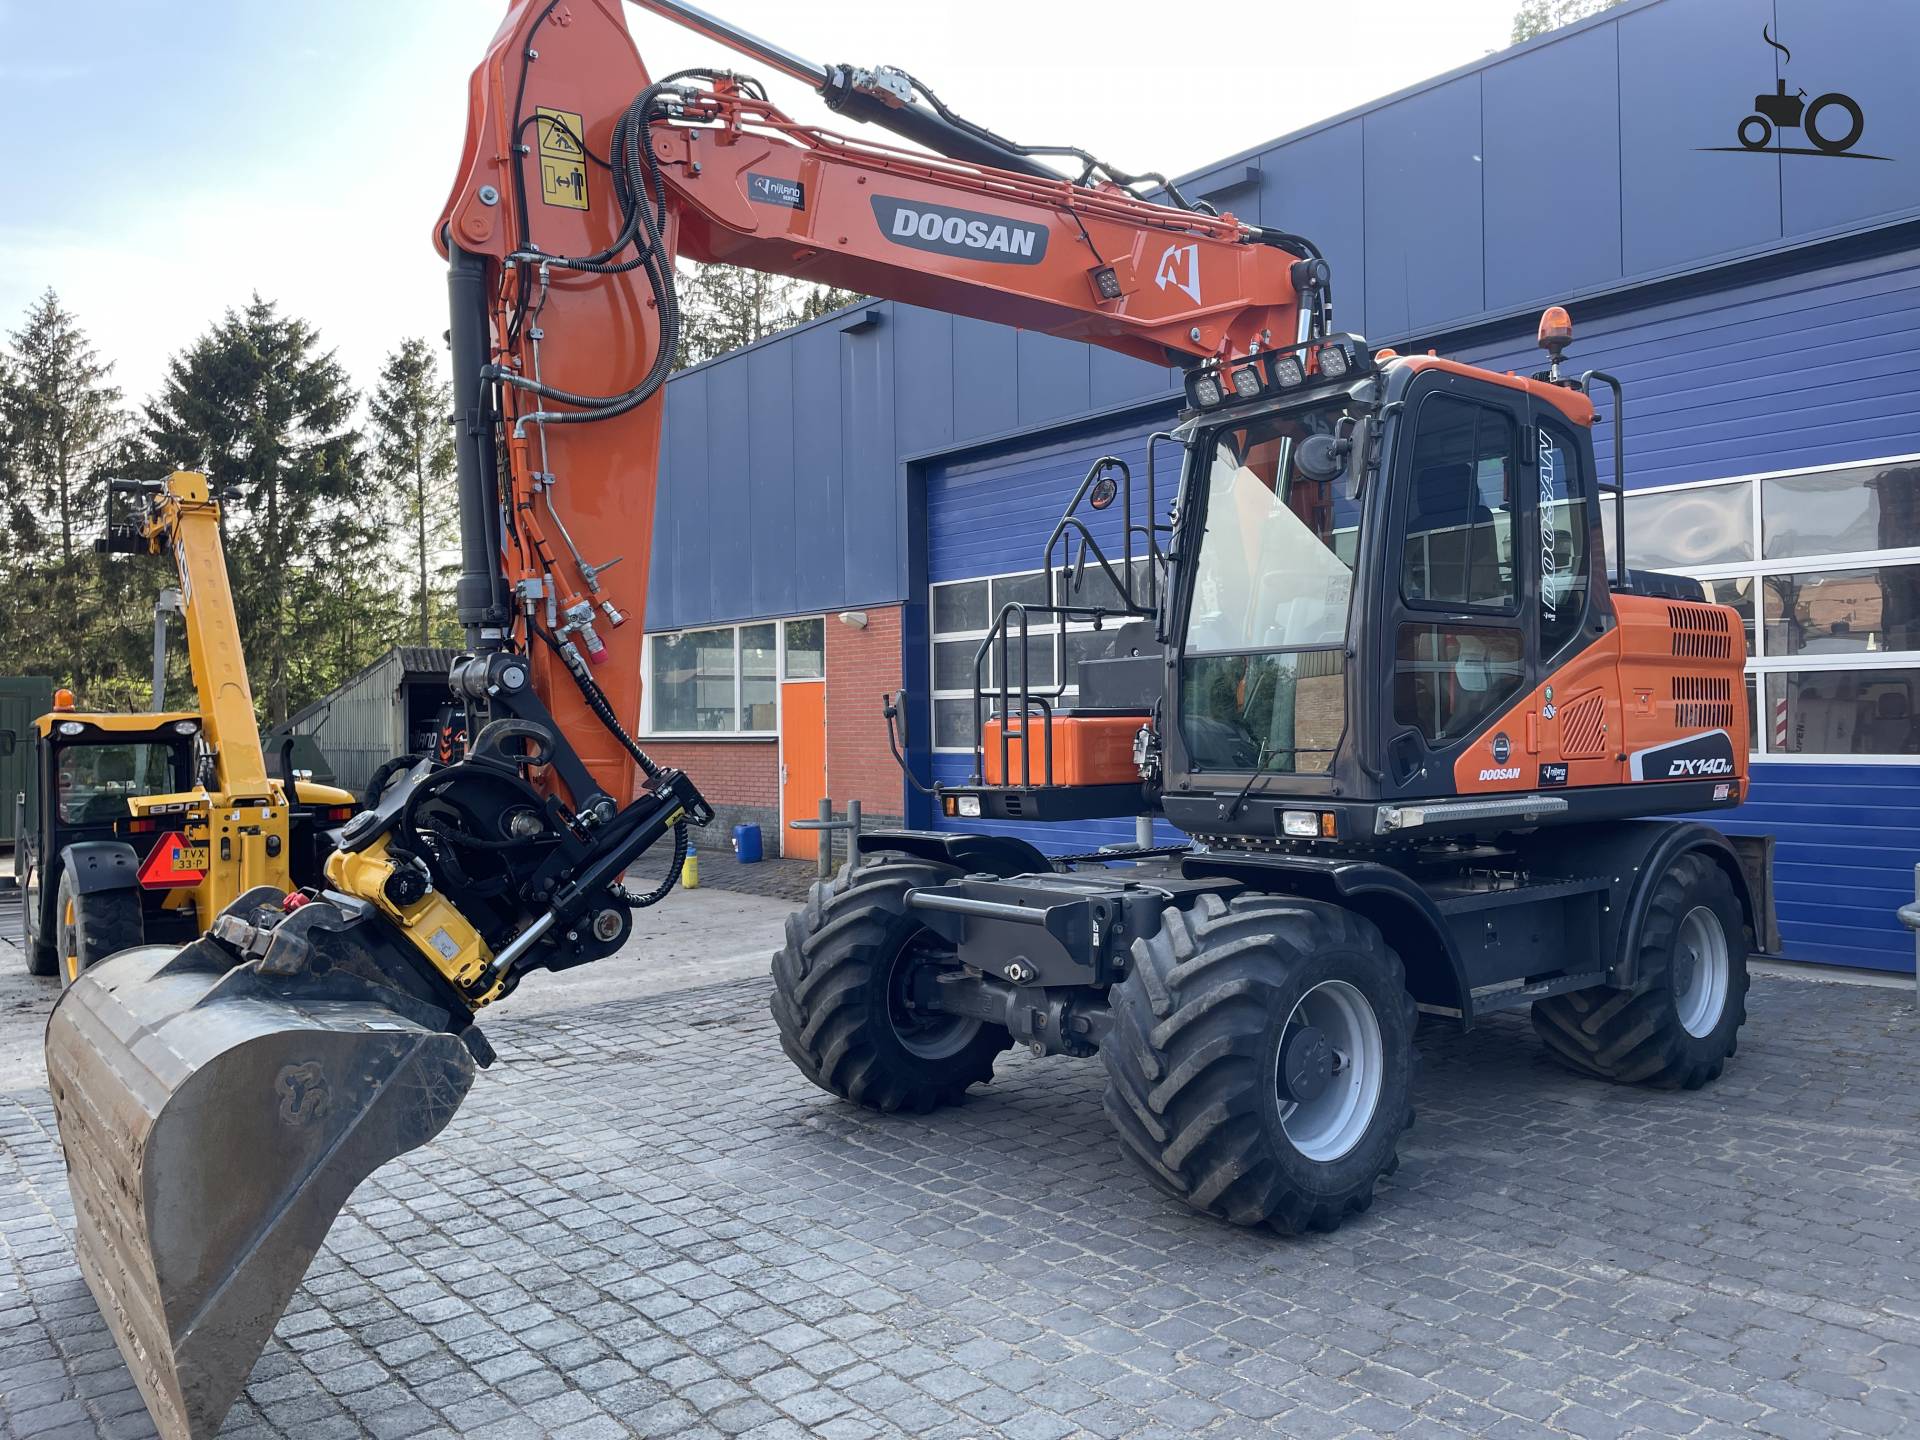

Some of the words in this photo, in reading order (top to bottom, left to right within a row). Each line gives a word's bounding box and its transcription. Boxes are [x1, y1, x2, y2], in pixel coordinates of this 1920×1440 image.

[892, 208, 1036, 256] DOOSAN
[1539, 429, 1556, 611] DOOSAN
[1479, 768, 1521, 781] DOOSAN
[184, 850, 204, 858] TVX
